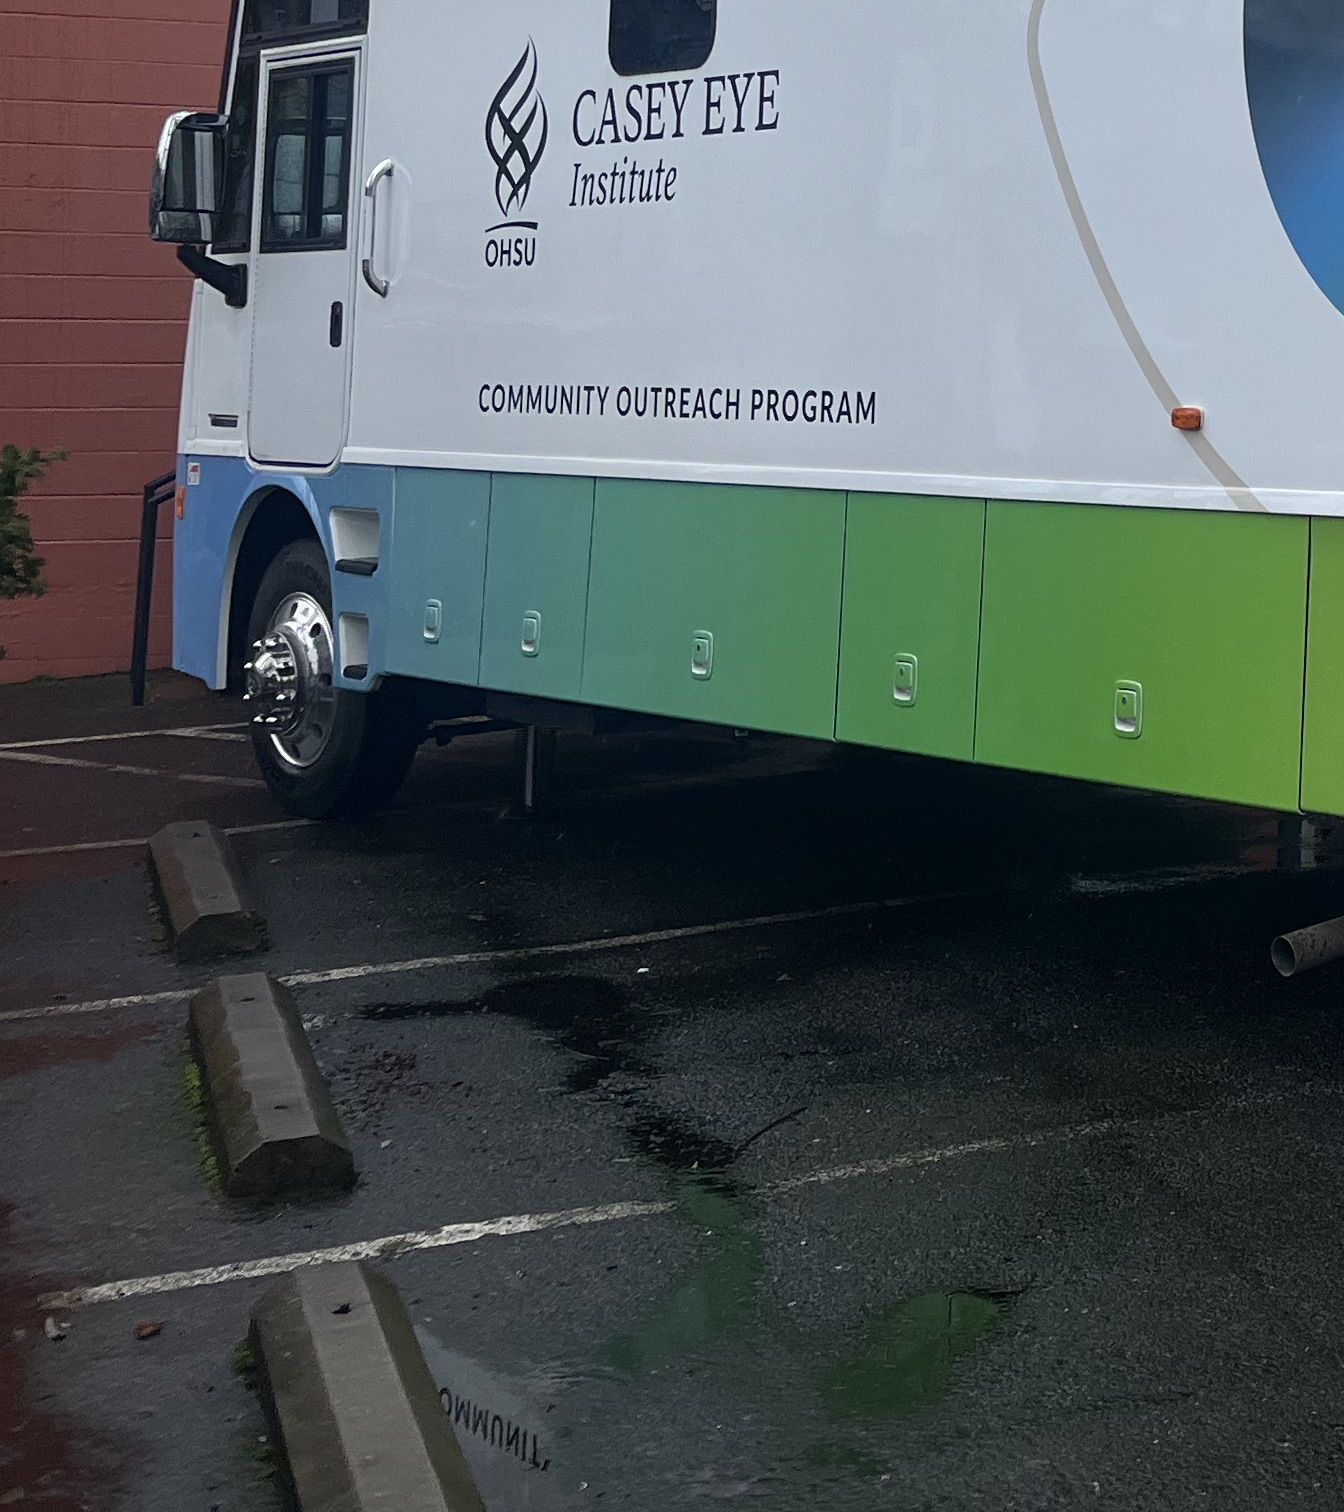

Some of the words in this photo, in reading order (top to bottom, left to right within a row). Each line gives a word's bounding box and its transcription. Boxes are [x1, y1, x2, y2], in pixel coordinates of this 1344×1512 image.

[572, 78, 693, 147] CASEY
[702, 69, 780, 136] EYE
[569, 156, 677, 206] Institute
[484, 237, 536, 268] OHSU
[478, 383, 609, 416] COMMUNITY
[616, 385, 741, 420] OUTREACH
[750, 388, 877, 425] PROGRAM
